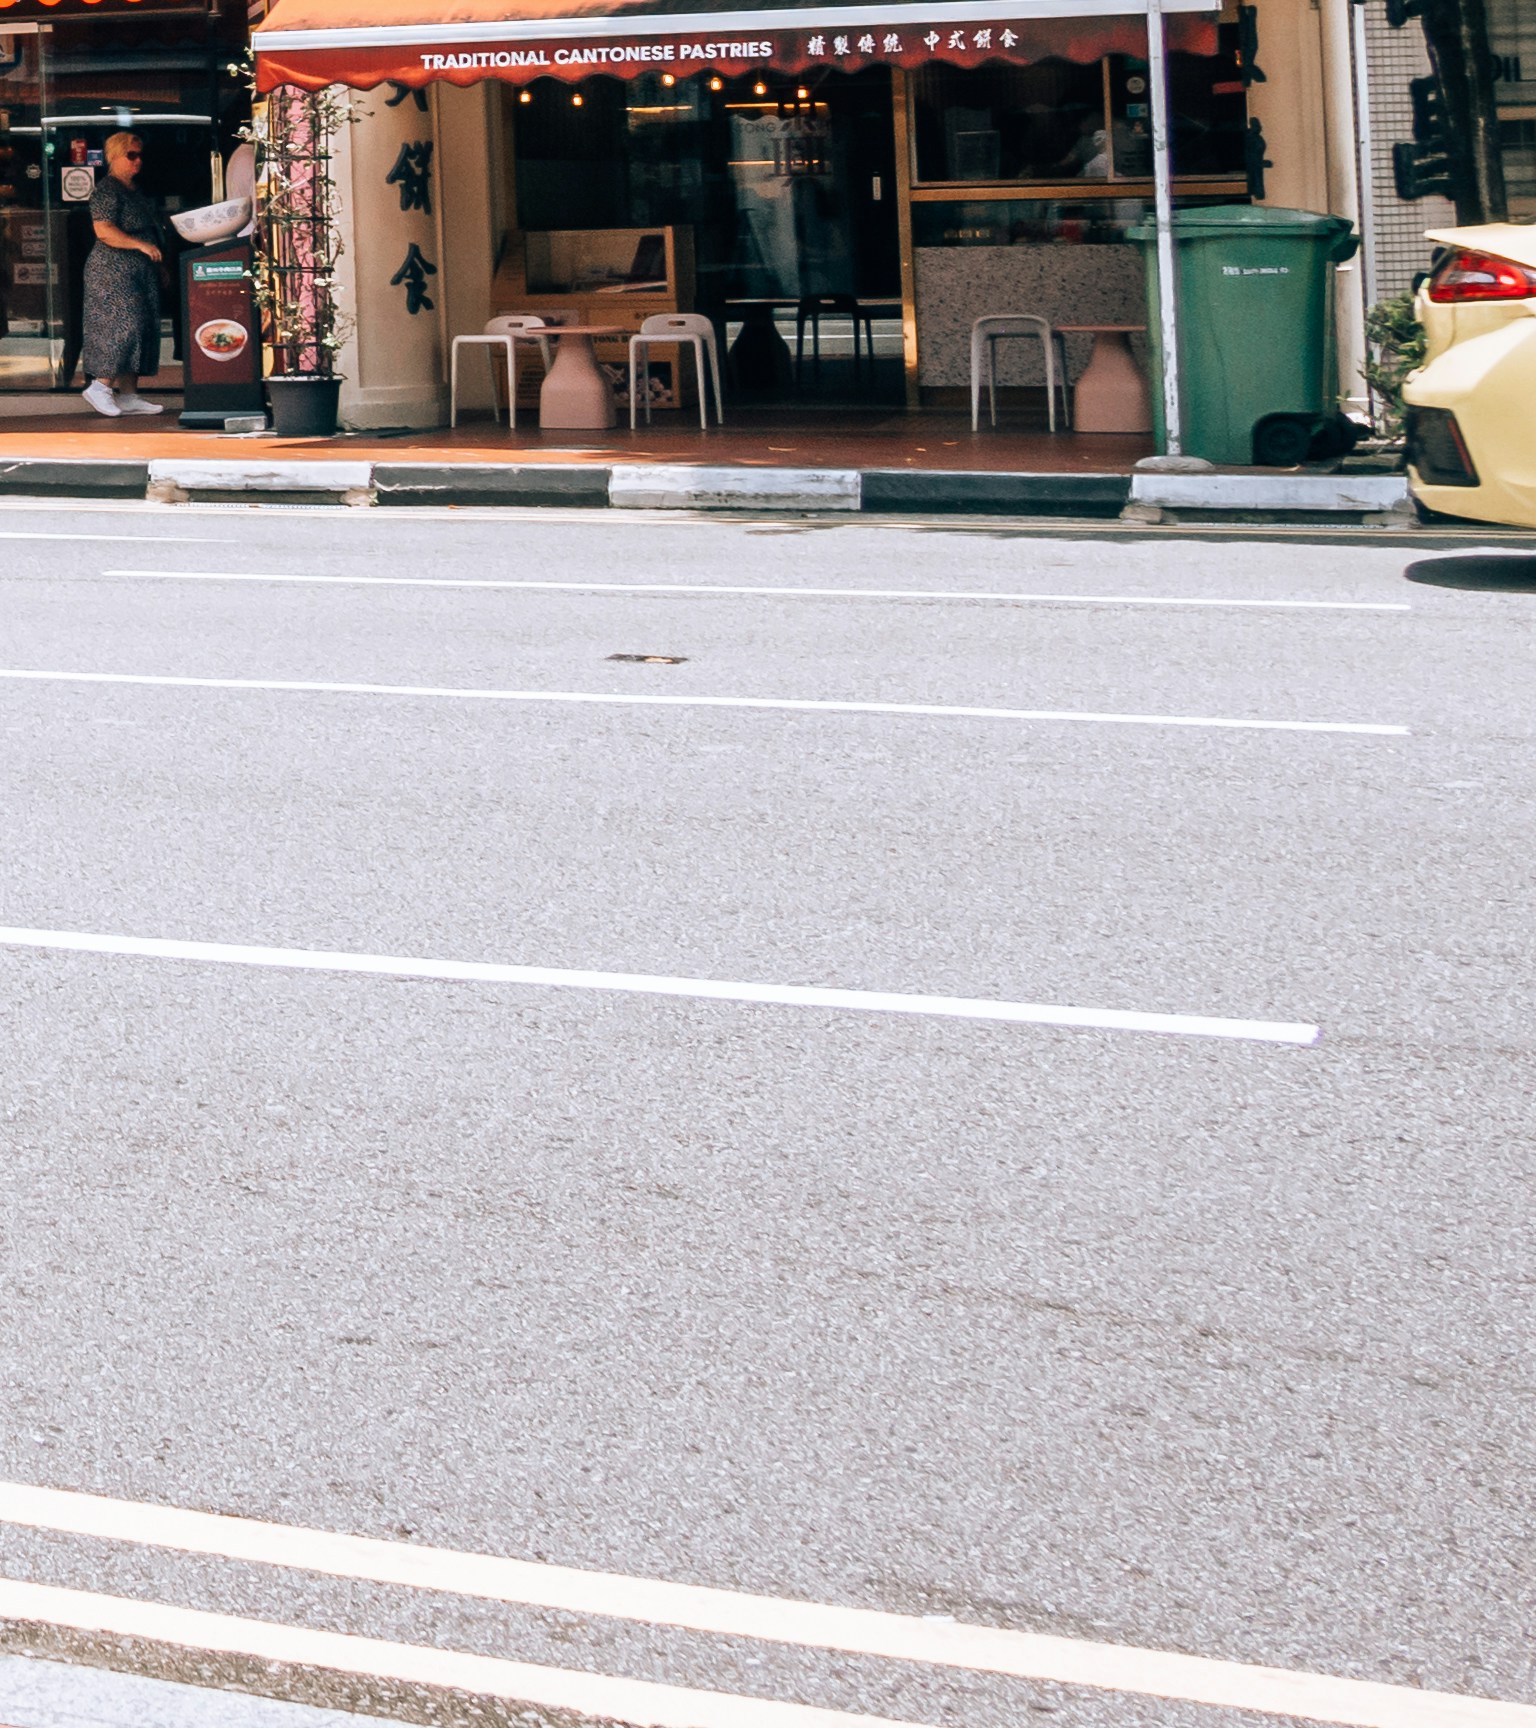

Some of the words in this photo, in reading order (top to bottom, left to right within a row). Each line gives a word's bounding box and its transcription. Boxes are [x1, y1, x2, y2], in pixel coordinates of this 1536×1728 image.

[420, 50, 551, 70] TRADITIONAL
[554, 46, 675, 66] CANTONESE
[679, 41, 773, 61] PASTRIES
